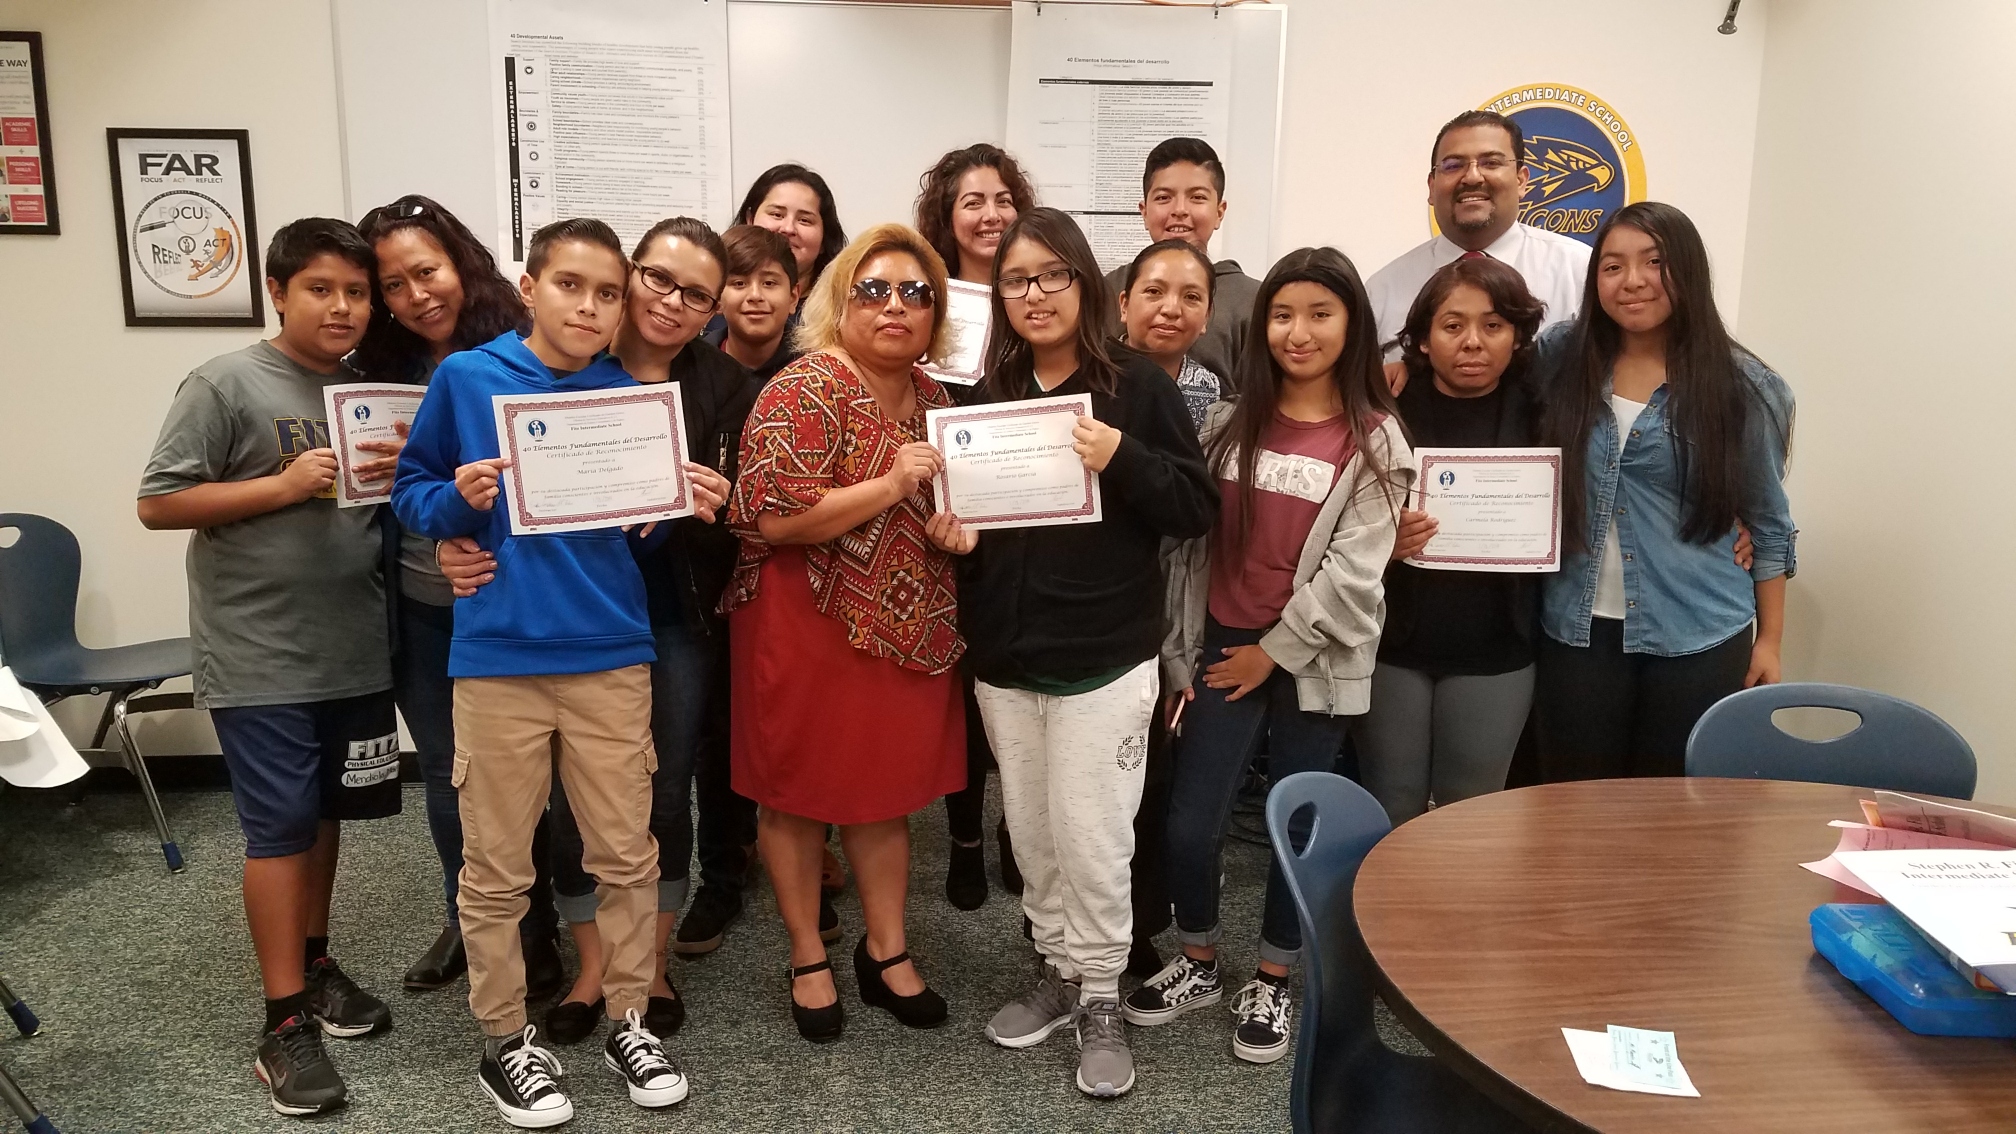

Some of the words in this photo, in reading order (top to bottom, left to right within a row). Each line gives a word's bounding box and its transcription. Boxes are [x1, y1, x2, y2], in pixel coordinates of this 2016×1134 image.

[6, 59, 28, 68] WAY
[1485, 88, 1587, 114] NTERMEDIATE
[1587, 100, 1634, 153] SCHOOL
[138, 153, 222, 177] FAR
[159, 206, 213, 220] FOCUS
[203, 238, 226, 248] ACT
[359, 425, 388, 433] Elementos
[533, 444, 567, 452] Elementos
[569, 439, 621, 451] Fundamentales
[622, 436, 633, 444] del
[634, 432, 668, 443] Desarrollo
[546, 449, 584, 460] Certificado
[596, 443, 648, 456] Reconocimiento
[970, 456, 1003, 466] Certificado
[1012, 451, 1059, 462] Reconocimiento
[990, 446, 1036, 457] Fundamentales
[598, 465, 624, 474] Delgado
[348, 731, 398, 759] FITZ
[1116, 744, 1146, 758] LOVE
[1908, 861, 1976, 872] Stephen
[1901, 871, 2010, 880] Intermediate
